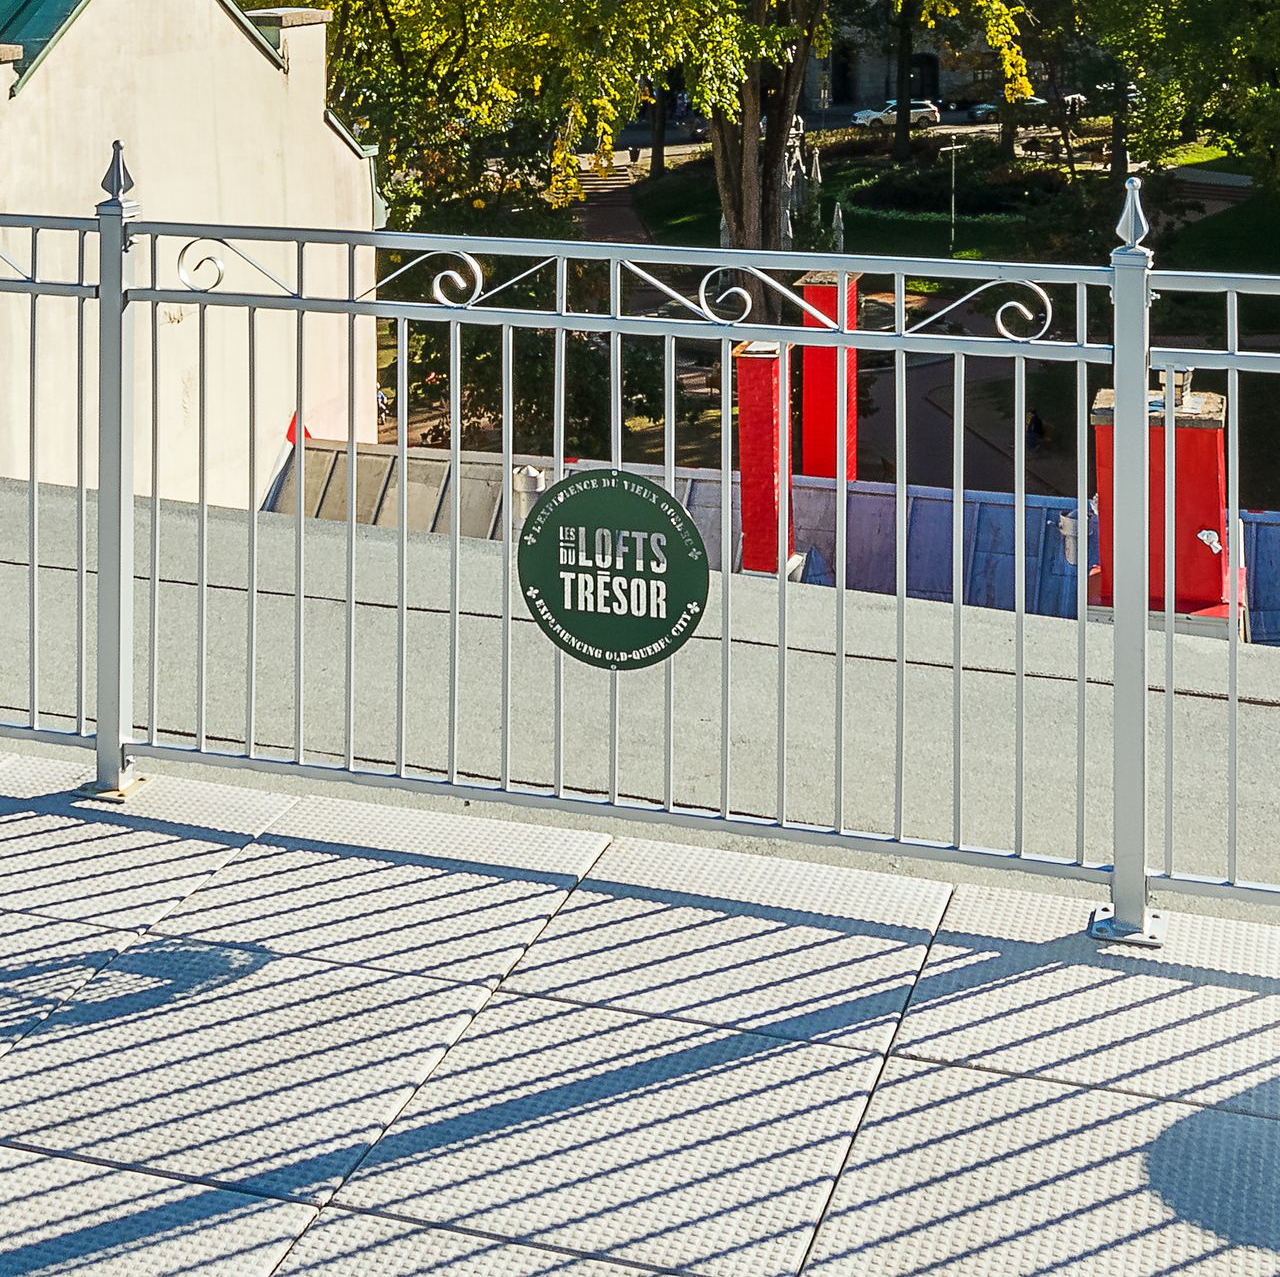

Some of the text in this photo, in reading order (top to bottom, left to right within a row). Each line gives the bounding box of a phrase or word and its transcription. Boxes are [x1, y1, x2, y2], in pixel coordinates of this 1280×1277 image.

[532, 479, 599, 534] L'EXPIENCE
[623, 480, 659, 505] VIEUX
[559, 525, 575, 541] LES
[559, 547, 575, 565] DU
[578, 526, 667, 574] LOFTS
[671, 611, 692, 637] CITY
